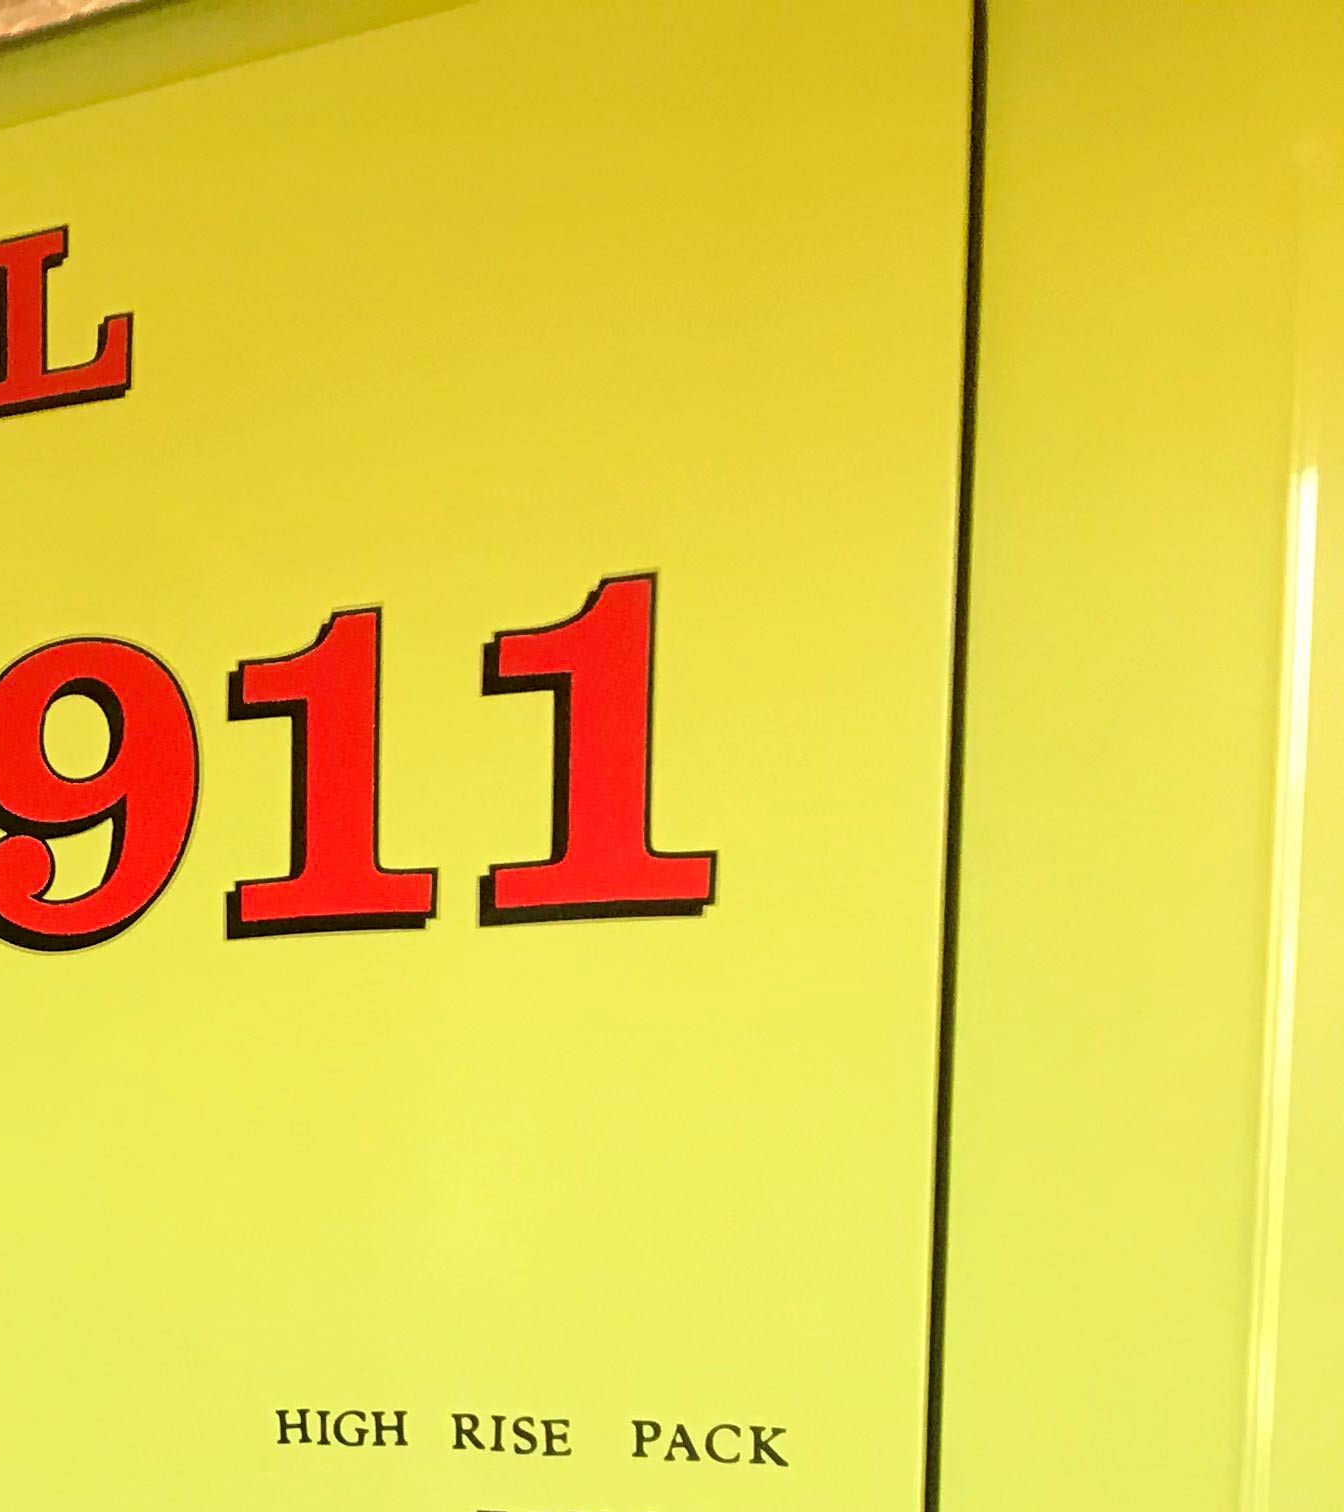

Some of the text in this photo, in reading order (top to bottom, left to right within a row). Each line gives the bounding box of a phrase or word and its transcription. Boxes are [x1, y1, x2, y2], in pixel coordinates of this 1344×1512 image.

[275, 1408, 790, 1468] HIGH RISE PACK
